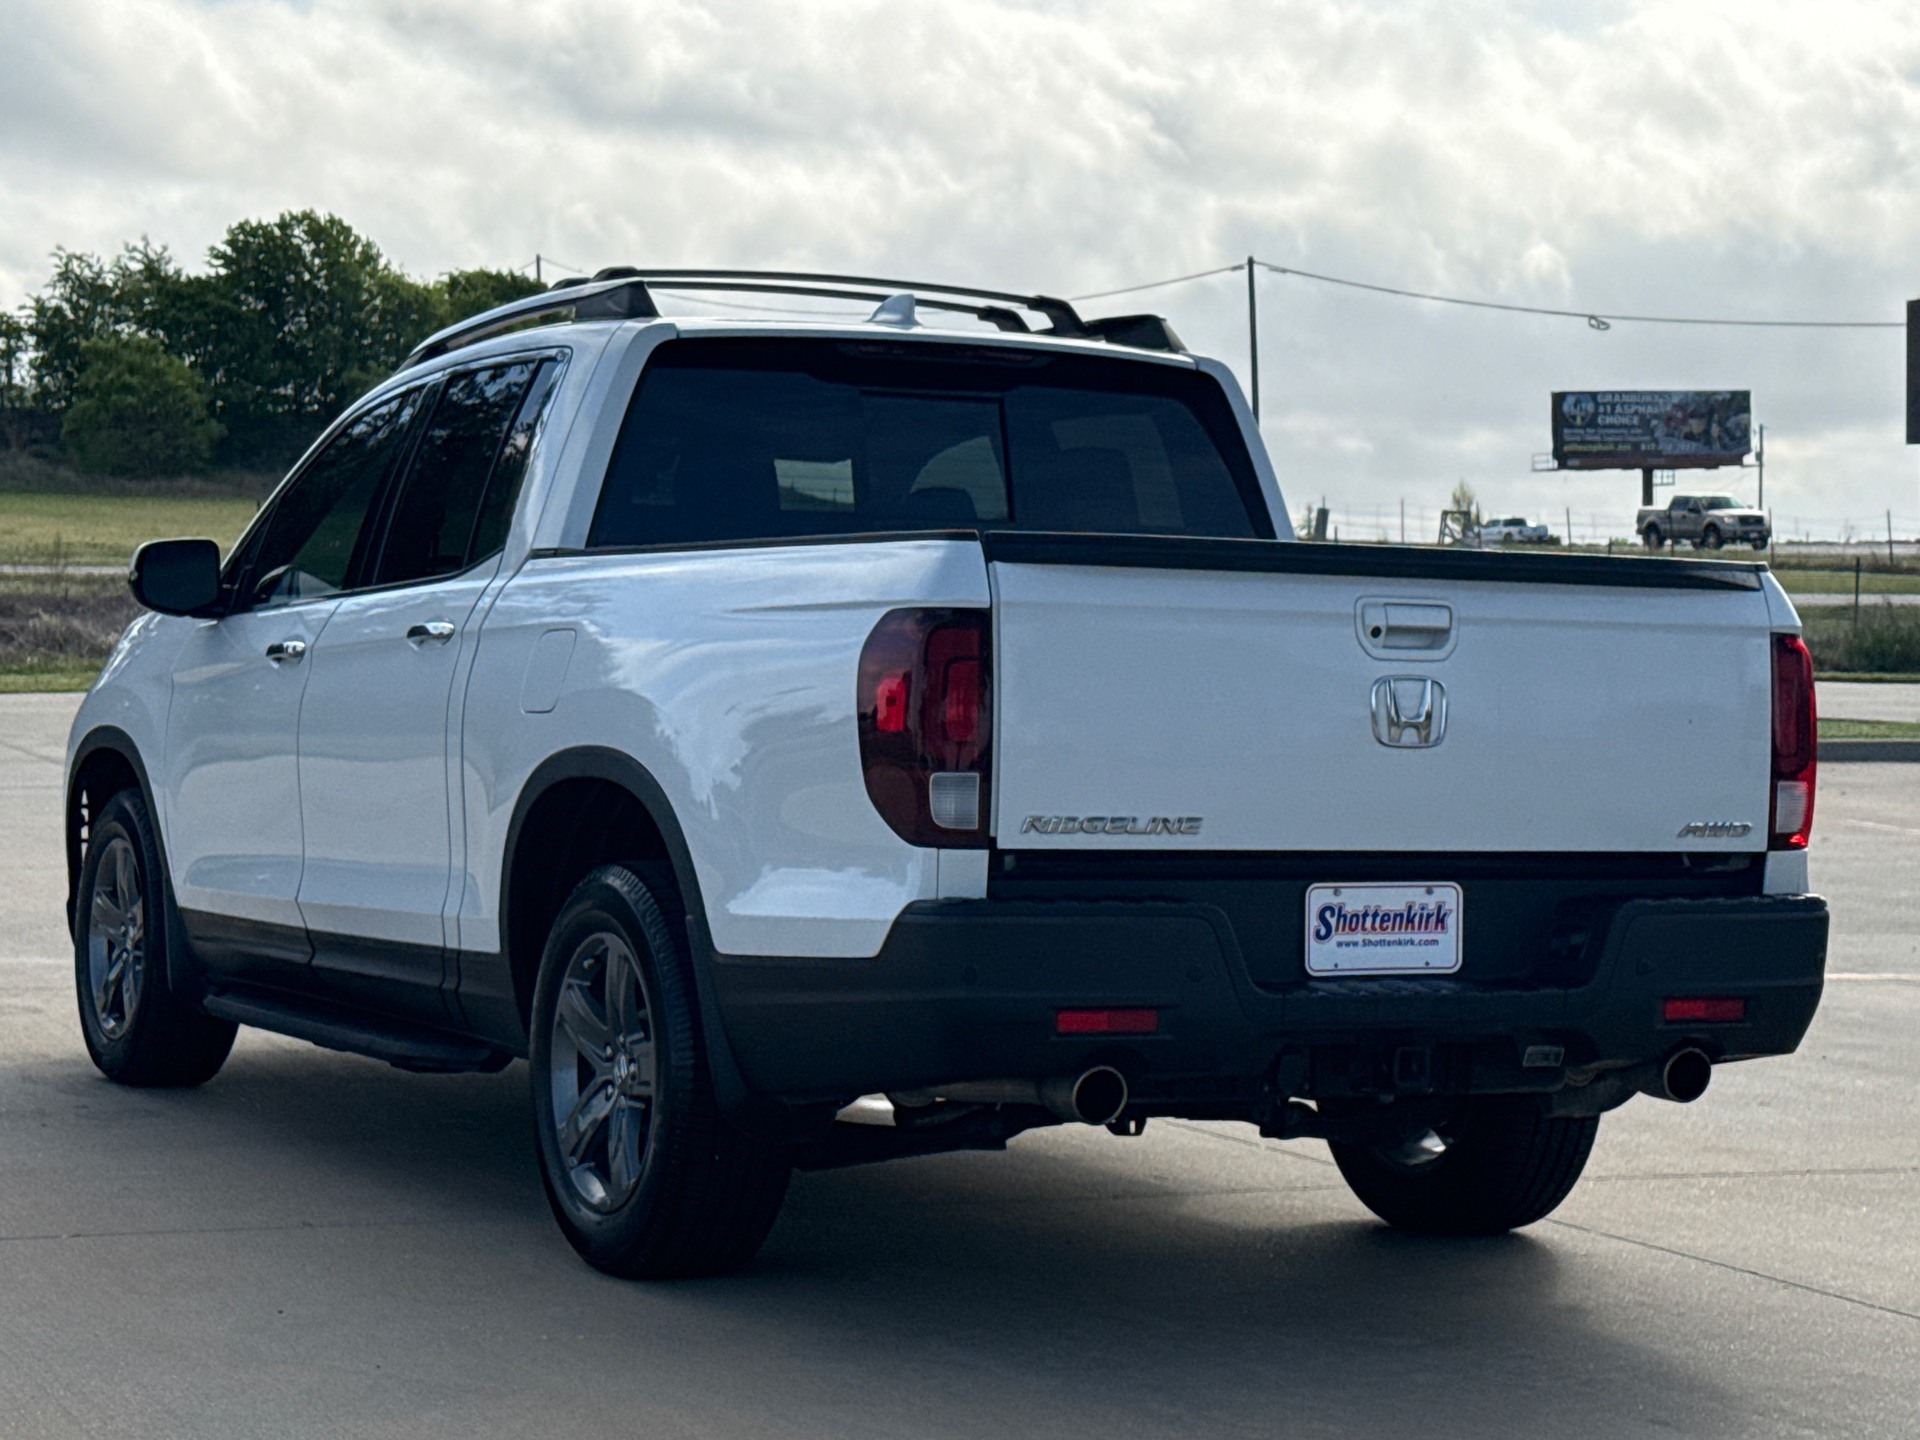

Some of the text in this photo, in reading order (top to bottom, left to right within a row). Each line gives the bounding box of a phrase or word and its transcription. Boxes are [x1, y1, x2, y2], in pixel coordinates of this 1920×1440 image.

[1021, 814, 1203, 835] RIDGELINE
[1677, 821, 1753, 838] AWD
[1314, 901, 1451, 943] Shottenkirk
[1335, 937, 1440, 949] www.Shottenkirk.com
